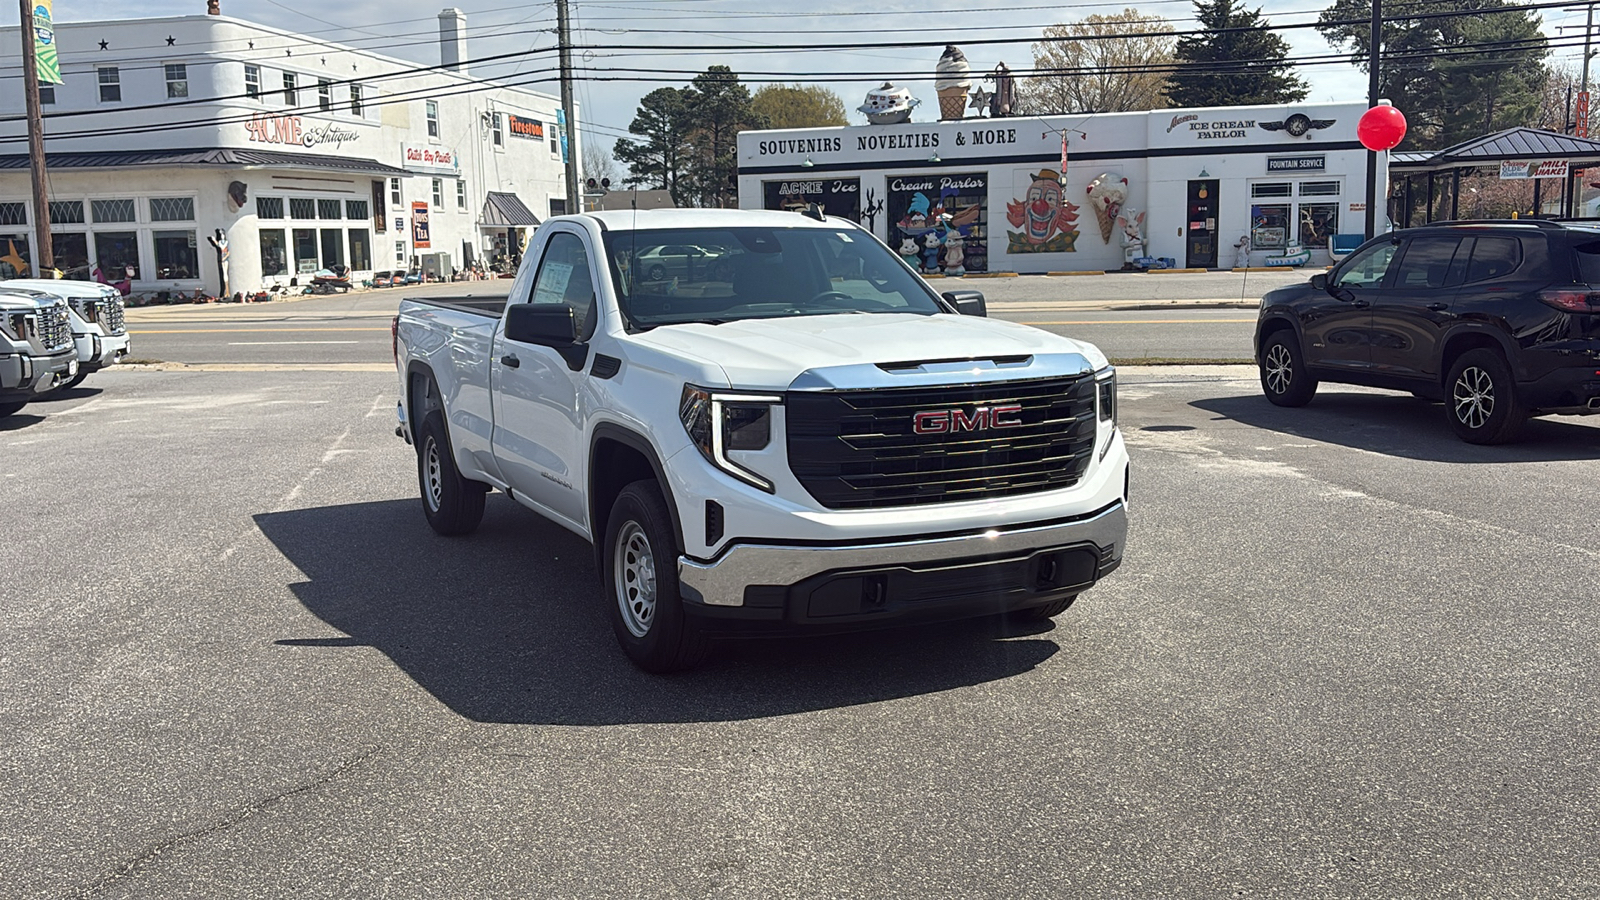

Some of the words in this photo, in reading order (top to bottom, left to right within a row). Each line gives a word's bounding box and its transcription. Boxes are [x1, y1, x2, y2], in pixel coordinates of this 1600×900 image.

[245, 111, 303, 146] ACME
[303, 121, 360, 150] Antiques
[1167, 114, 1198, 133] Acme
[1189, 122, 1209, 130] ICE
[1211, 120, 1255, 130] CREAM
[759, 137, 842, 155] SOUVENIRS
[857, 132, 940, 151] NOVELTIES
[955, 131, 966, 146] &
[972, 129, 1017, 146] MORE
[1197, 130, 1246, 139] PARLOR
[407, 147, 422, 161] Dutch
[423, 149, 434, 165] Boy
[434, 150, 452, 164] Paints
[1269, 160, 1298, 169] FOUNTAIN
[1299, 159, 1323, 168] SERVICE
[1541, 160, 1569, 168] MILK
[1534, 168, 1567, 176] SHAKES
[779, 181, 823, 195] ACME
[831, 180, 858, 193] Ice
[891, 178, 934, 192] Cream
[940, 177, 985, 190] Parlor
[416, 227, 428, 240] TEA
[913, 404, 1022, 435] GMC
